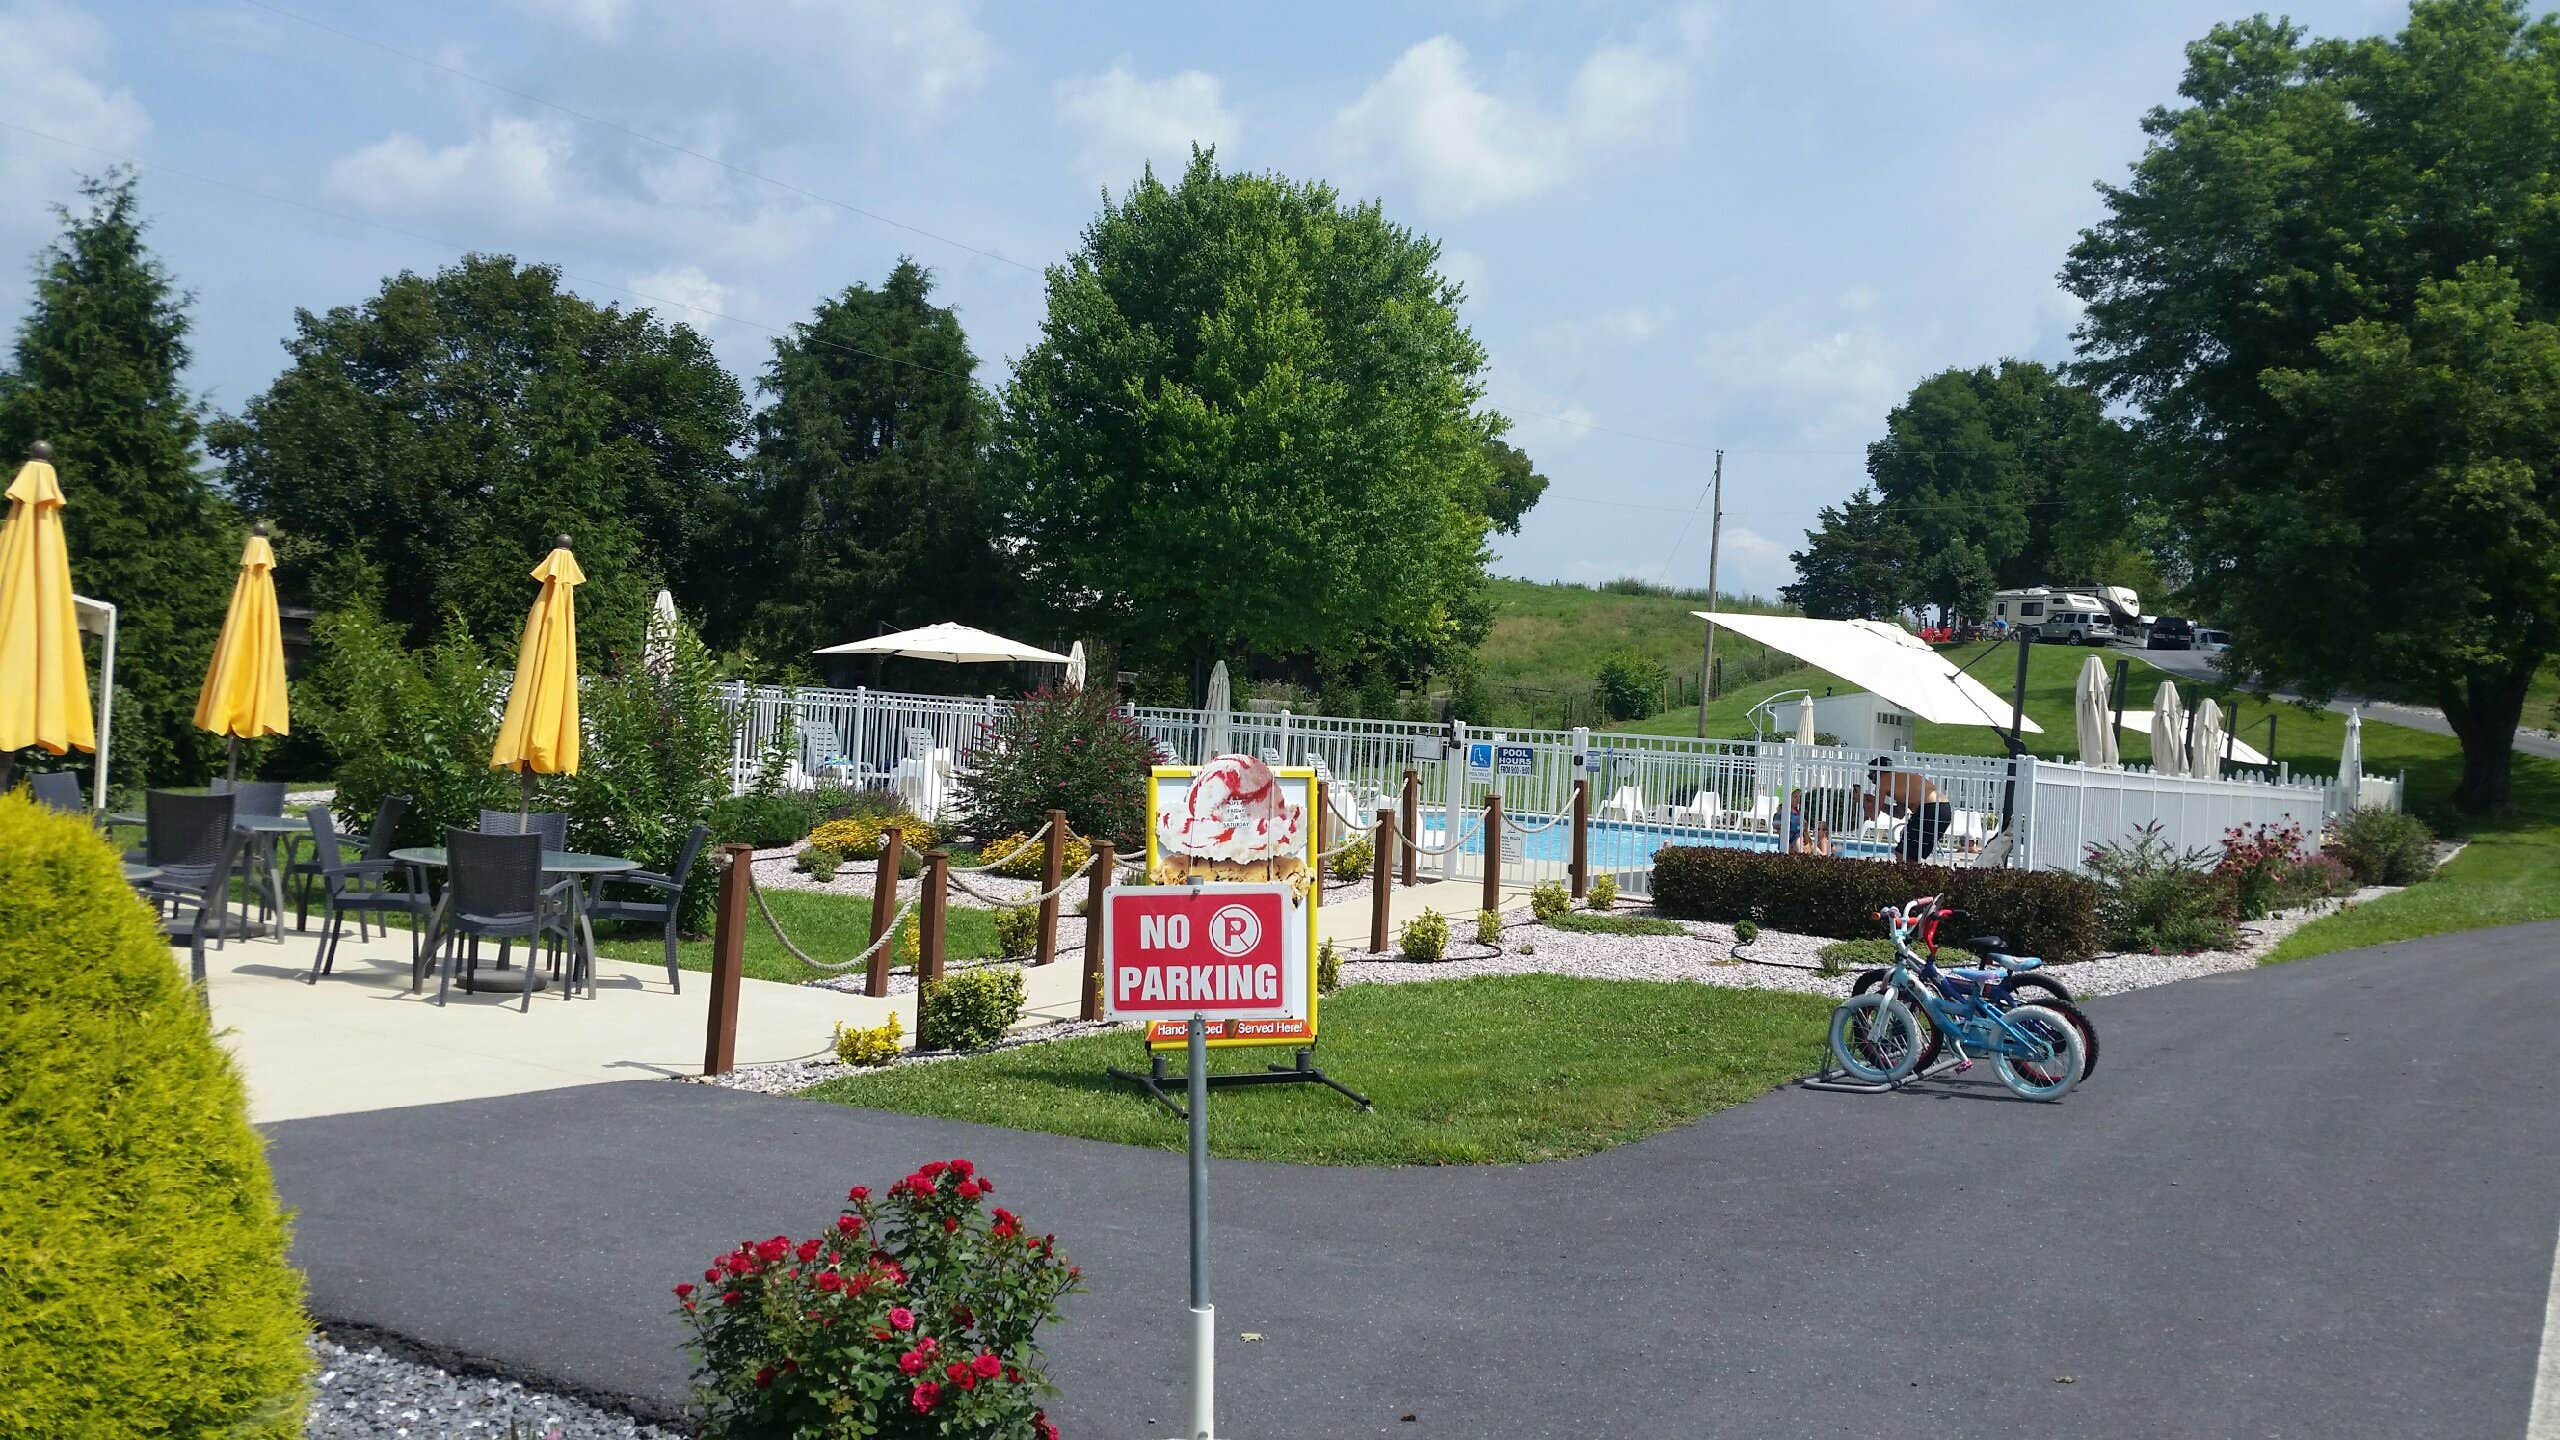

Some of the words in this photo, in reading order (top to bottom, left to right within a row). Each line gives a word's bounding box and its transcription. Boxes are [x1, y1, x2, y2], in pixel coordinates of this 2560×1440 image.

[1502, 749, 1528, 757] POOL
[1499, 757, 1532, 765] HOURS
[1140, 914, 1190, 949] NO
[1119, 964, 1277, 1001] PARKING
[1238, 1022, 1273, 1034] Served
[1276, 1022, 1303, 1033] Here!
